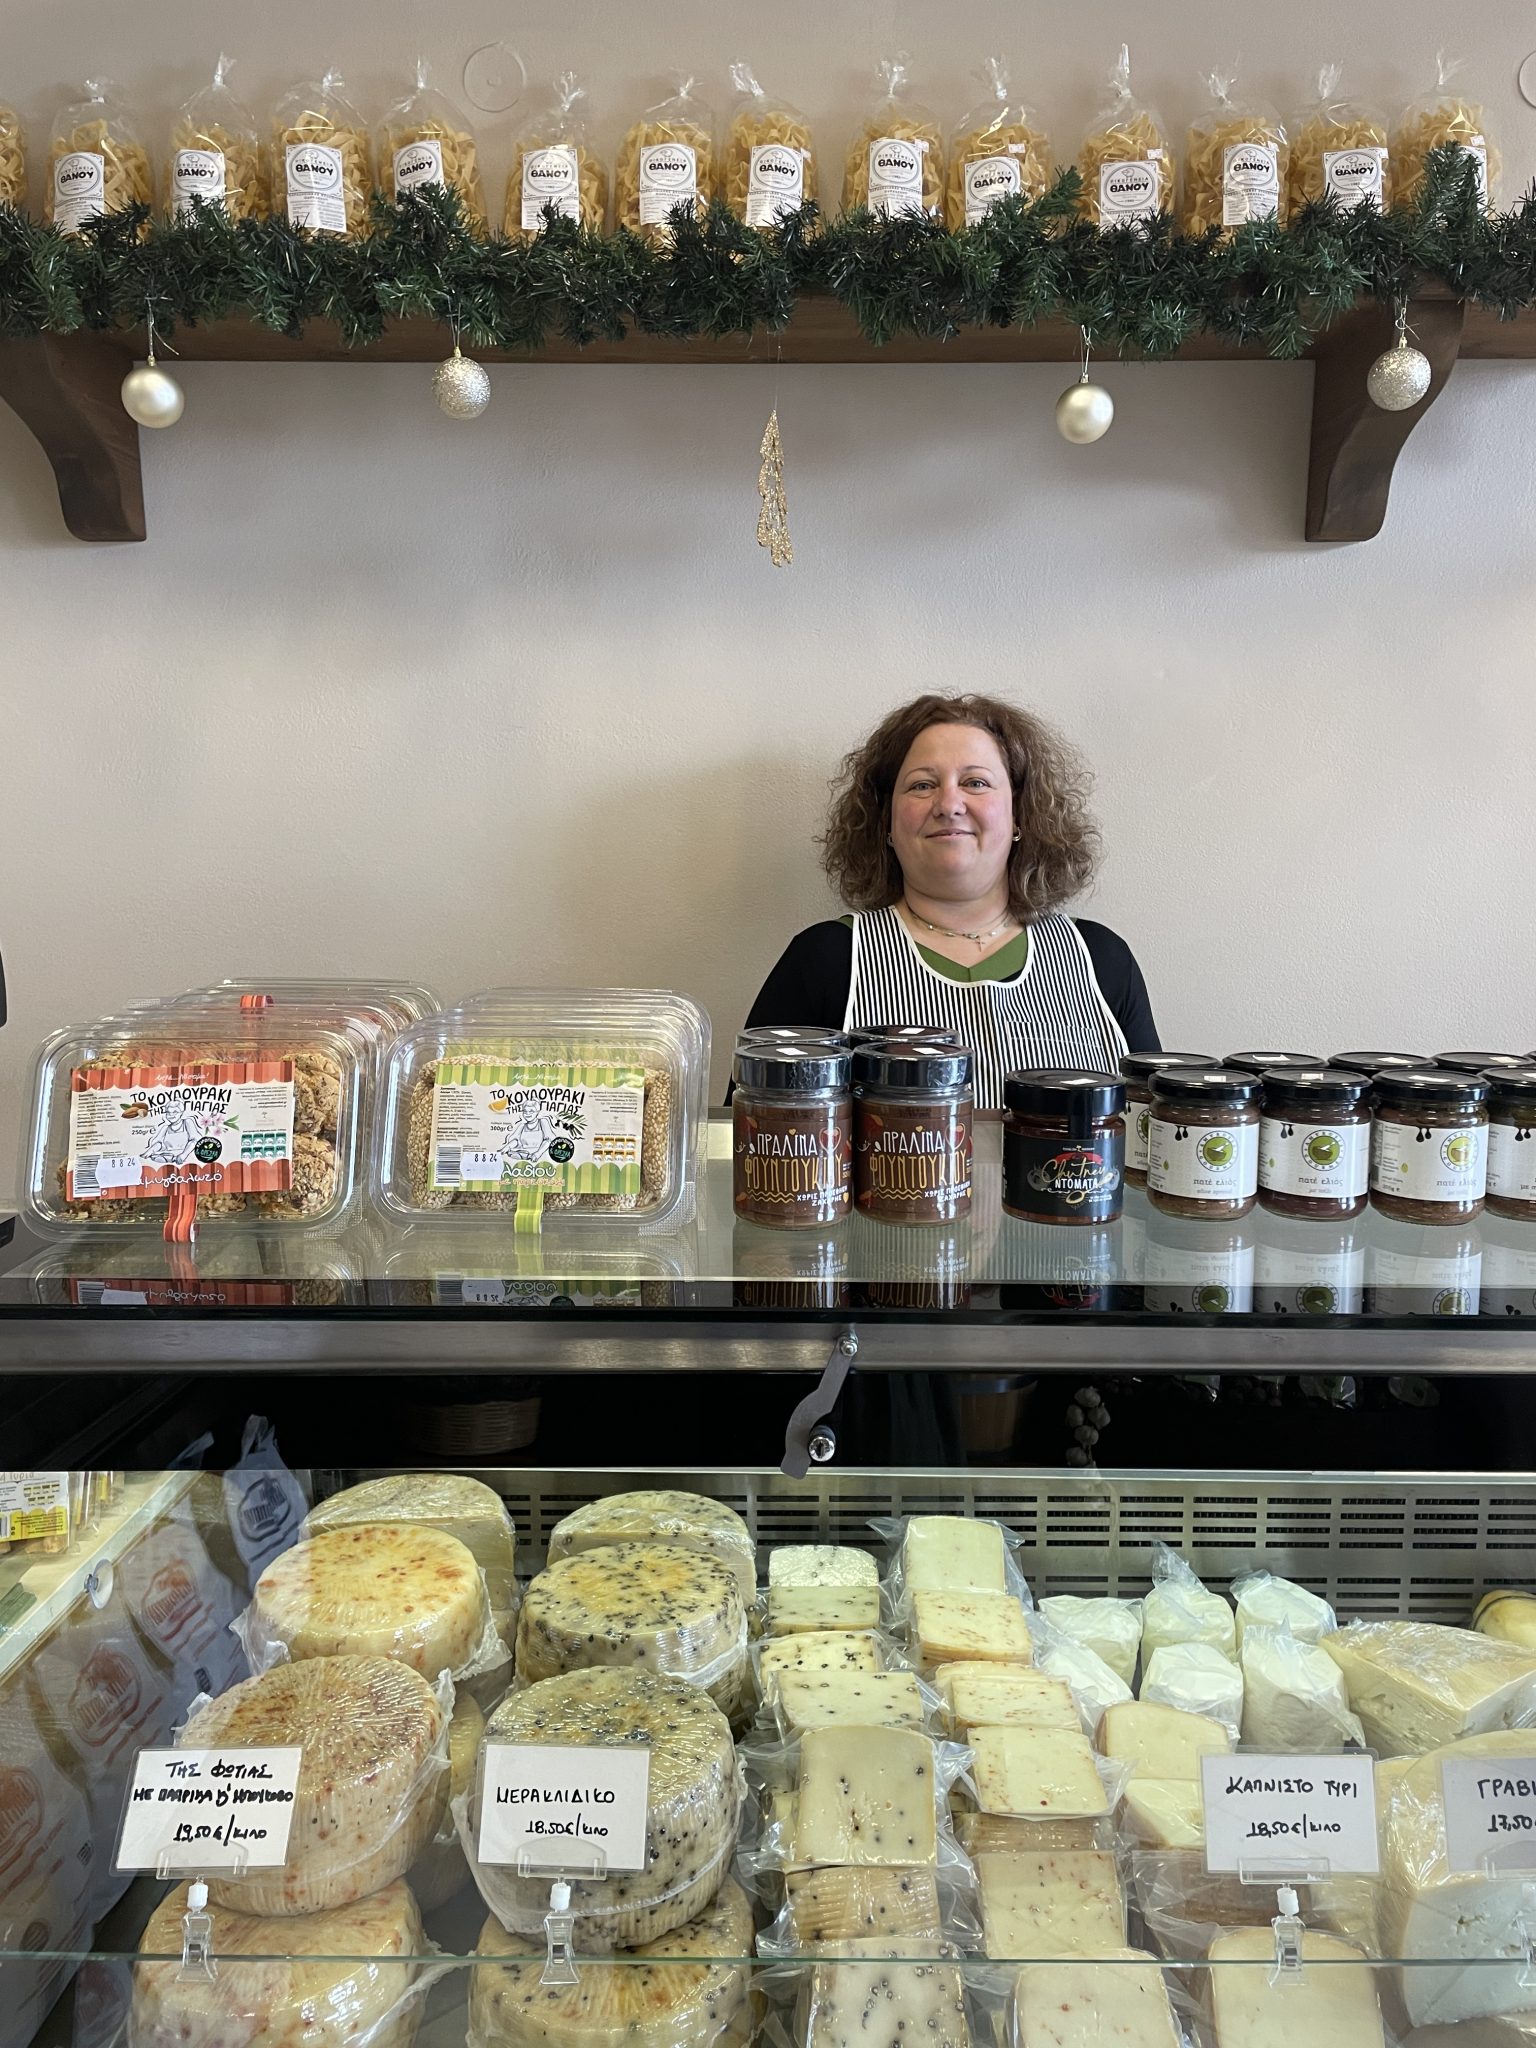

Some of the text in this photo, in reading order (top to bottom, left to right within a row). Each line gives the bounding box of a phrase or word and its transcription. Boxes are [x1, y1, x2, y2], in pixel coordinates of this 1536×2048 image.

[295, 164, 334, 177] ΘΑΝΟΥ
[400, 160, 433, 177] ΘΑΝΟΥ
[649, 162, 687, 172] ΘΑΝΟΥ
[759, 164, 796, 177] ΘΑΝΟΥ
[877, 158, 915, 170] ΘΑΝΟΥ
[1233, 162, 1270, 173] ΘΑΝΟΥ
[60, 171, 94, 184] ΘΑΝΟΥ
[177, 168, 215, 178] ΘΑΝΟΥ
[530, 169, 569, 179] ΘΑΝΟΥ
[1335, 167, 1374, 176] ΘΑΝΟΥ
[973, 175, 1012, 188] ΘΑΝΟΥ
[1110, 181, 1150, 193] ΘΑΝΟΥ
[130, 1091, 147, 1103] ΤΟ
[147, 1086, 232, 1108] ΚΟΥΛΟΥΡΑΚΙ
[489, 1089, 505, 1101] ΤΟ
[506, 1088, 585, 1107] ΚΟΥΛΟΥΡΑΚΙ
[148, 1101, 228, 1117] ΤΗΣ ΓΙΑΓΙΑΣ
[506, 1104, 524, 1115] ΤΗΣ
[539, 1100, 582, 1116] ΓΙΑΓΙΑΣ
[757, 1133, 818, 1157] ΠΡΑΛΙΝΑ
[883, 1130, 945, 1154] ΠΡΑΛΙΝΑ
[474, 1153, 479, 1162] 8
[481, 1153, 486, 1162] 8
[1054, 1178, 1098, 1190] ΝΤΟΜΑΤΑ
[165, 1759, 273, 1779] ΤΗΣ ΦΩΤΙΑΣ
[1225, 1776, 1357, 1798] ΚΑΠΝΙΣΤΟ ΤΥΡΙ
[496, 1786, 615, 1803] ΜΕΡΑΚΛΙΔΙΚΟ
